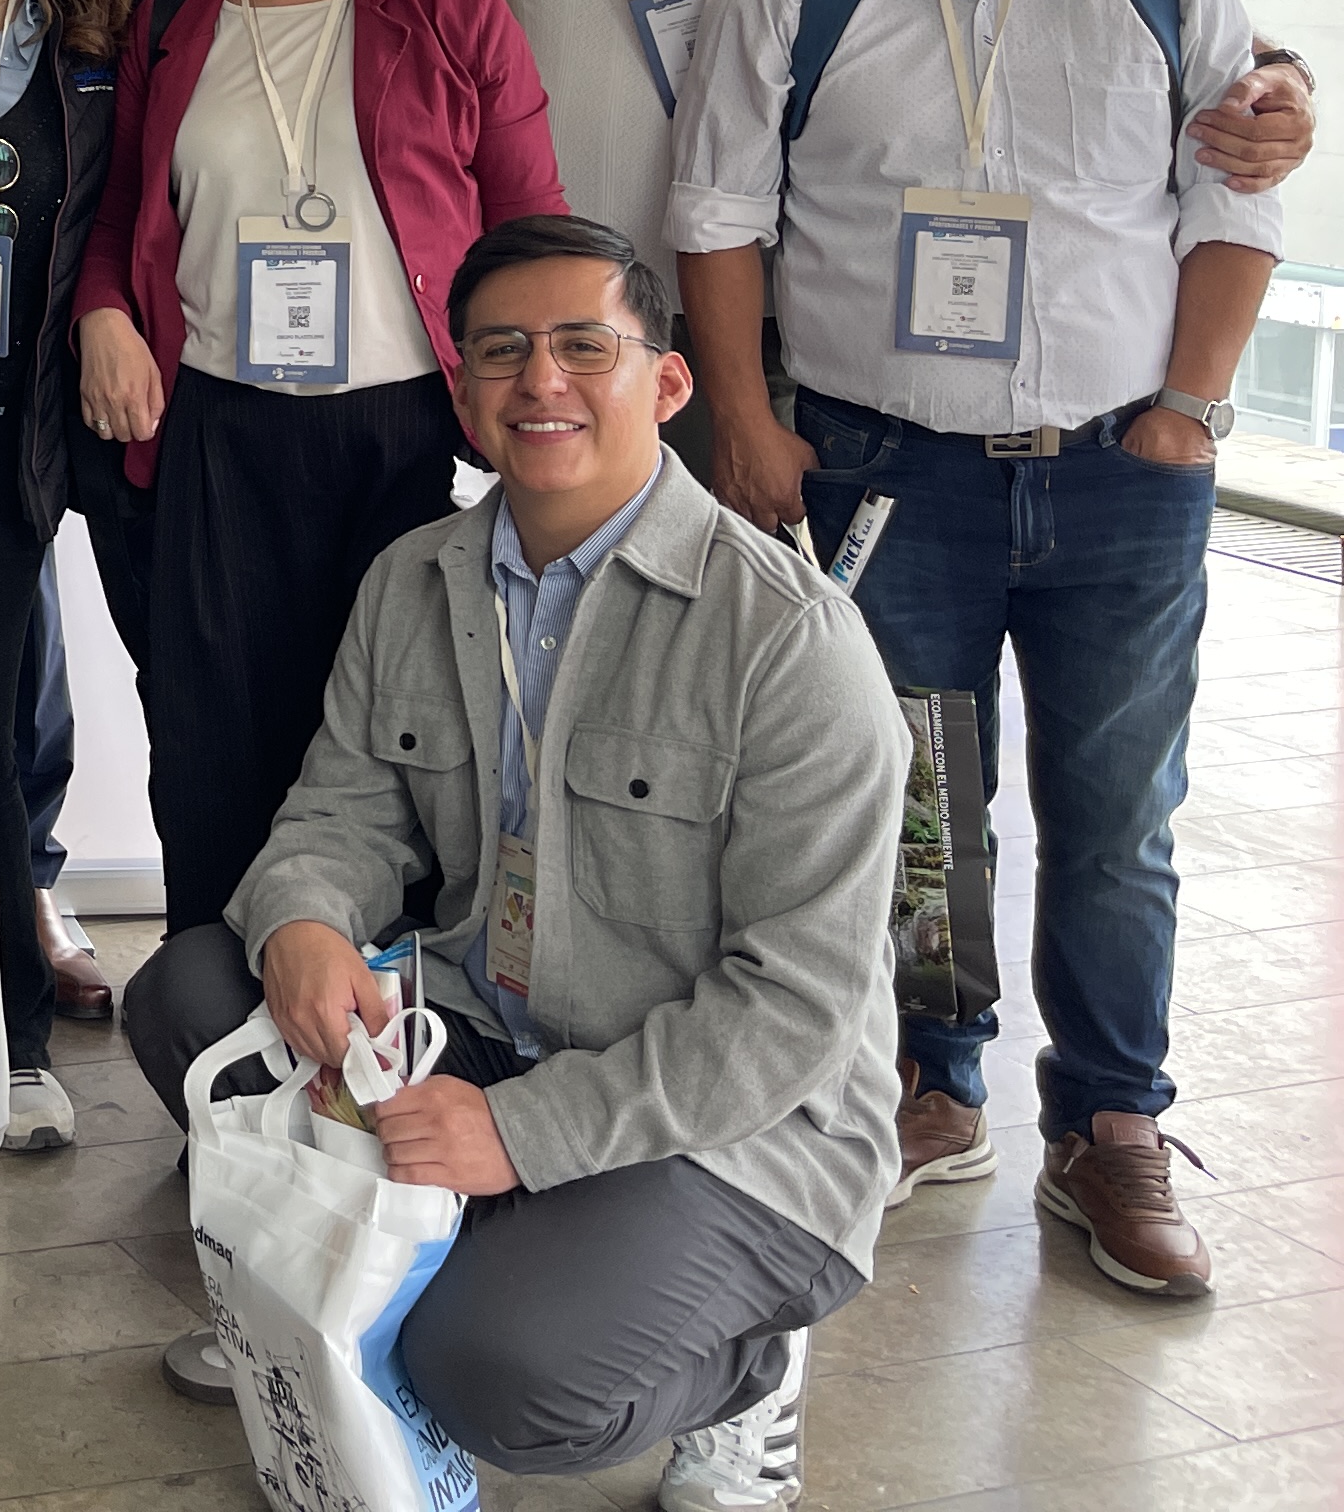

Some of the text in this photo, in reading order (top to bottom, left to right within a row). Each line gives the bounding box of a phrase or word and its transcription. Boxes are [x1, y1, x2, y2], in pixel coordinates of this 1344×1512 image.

[832, 531, 866, 584] Pack
[929, 693, 954, 871] ECOAMIGOS CON EL MEDIO AMBIENTE
[194, 1226, 233, 1270] dmaq
